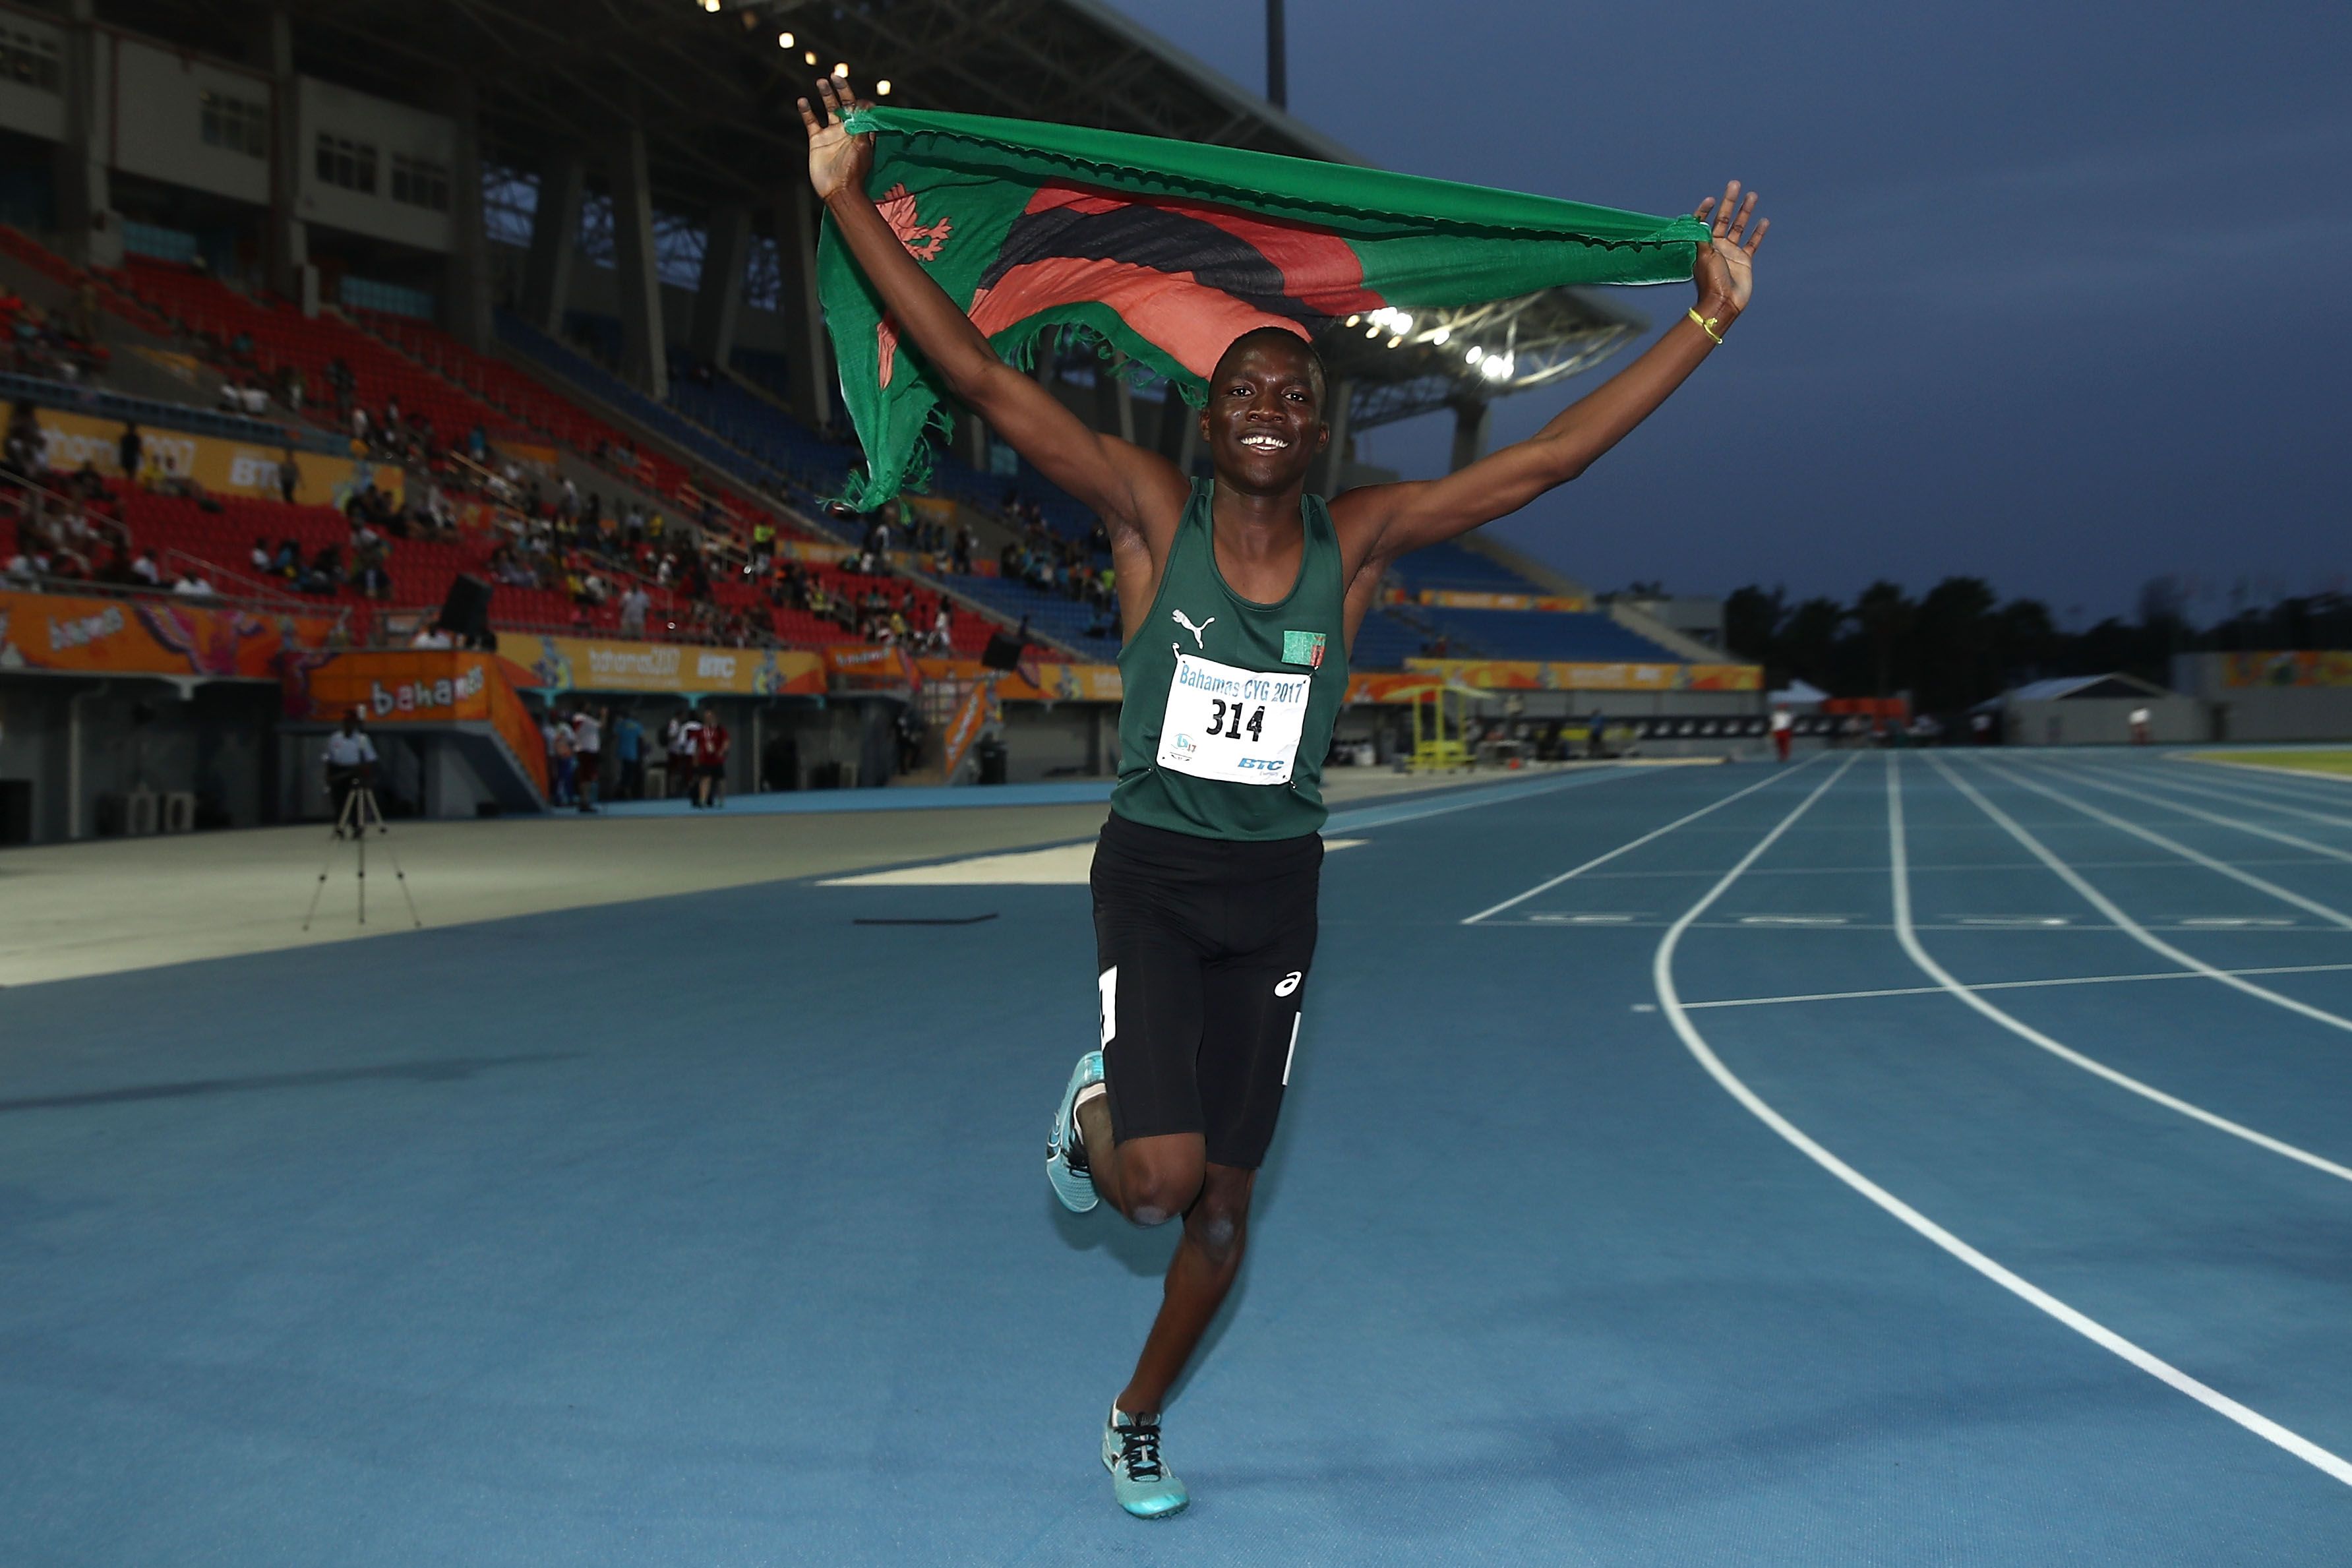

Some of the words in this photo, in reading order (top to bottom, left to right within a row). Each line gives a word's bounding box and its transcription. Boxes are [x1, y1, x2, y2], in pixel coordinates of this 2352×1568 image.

[1180, 665, 1240, 697] Bahamas
[1244, 680, 1269, 700] CYG
[1271, 683, 1303, 703] 2017
[1206, 699, 1265, 742] 314
[1238, 758, 1284, 771] BTC
